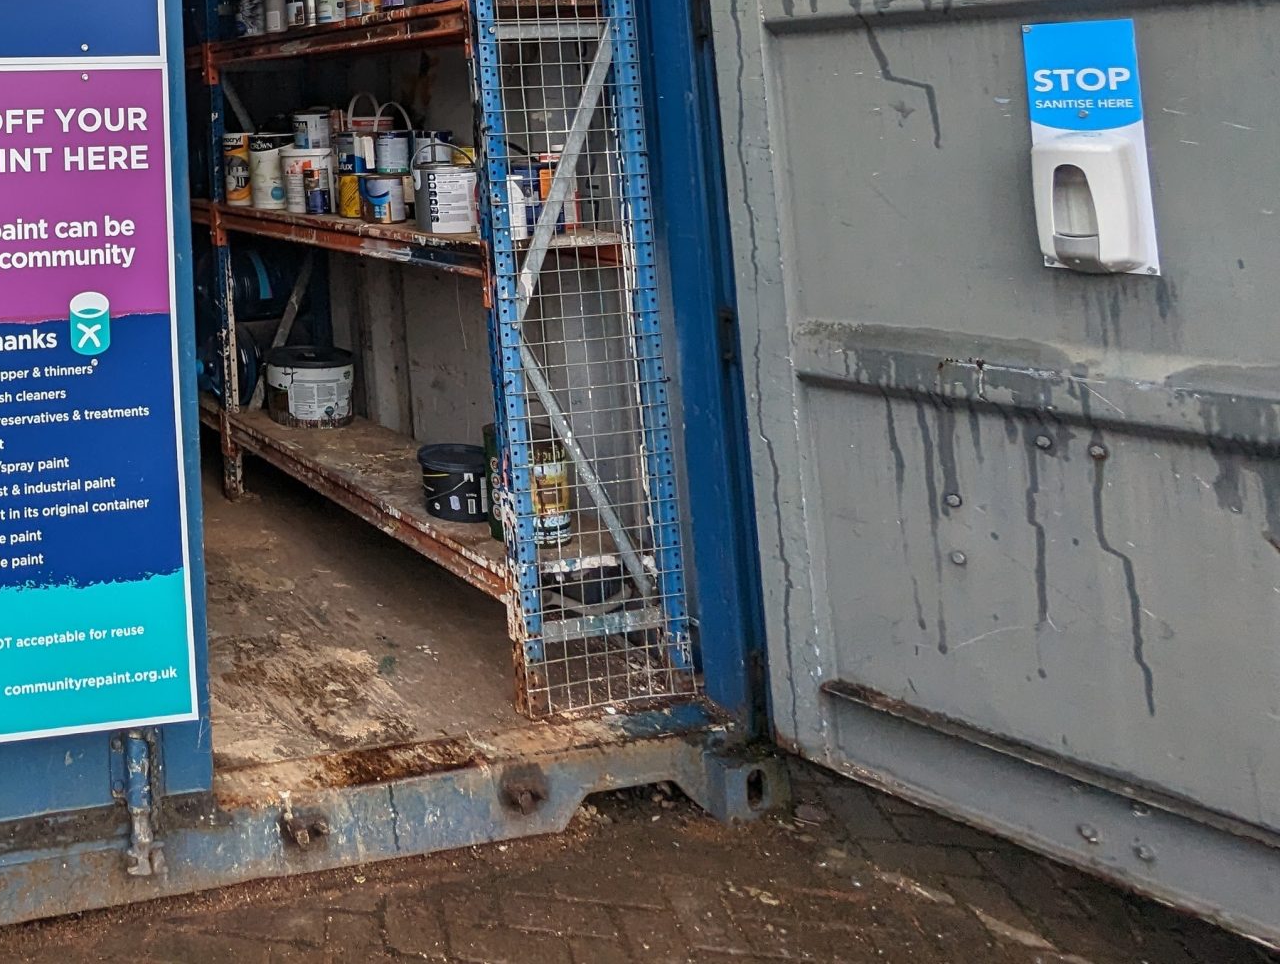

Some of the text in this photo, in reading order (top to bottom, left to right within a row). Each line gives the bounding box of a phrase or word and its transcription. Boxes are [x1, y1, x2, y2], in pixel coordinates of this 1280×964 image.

[1034, 67, 1130, 92] STOP
[1036, 99, 1133, 108] SANITISE HERE
[55, 107, 147, 132] YOUR
[64, 145, 149, 171] HERE
[55, 221, 97, 238] can
[105, 215, 135, 236] be
[32, 367, 40, 377] &
[44, 365, 93, 377] thinners
[16, 390, 66, 402] cleaners
[72, 410, 81, 420] &
[84, 406, 149, 420] treatments
[38, 457, 69, 472] paint
[12, 484, 20, 495] &
[24, 479, 81, 494] industrial
[85, 477, 115, 491] paint
[9, 508, 20, 519] in
[24, 507, 39, 518] its
[42, 502, 88, 517] original
[92, 498, 149, 512] container
[10, 530, 42, 545] paint
[12, 554, 43, 569] paint
[16, 630, 86, 647] acceptable
[89, 629, 107, 639] for
[111, 626, 144, 637] reuse
[4, 666, 177, 696] communityrepaint.org.uk
